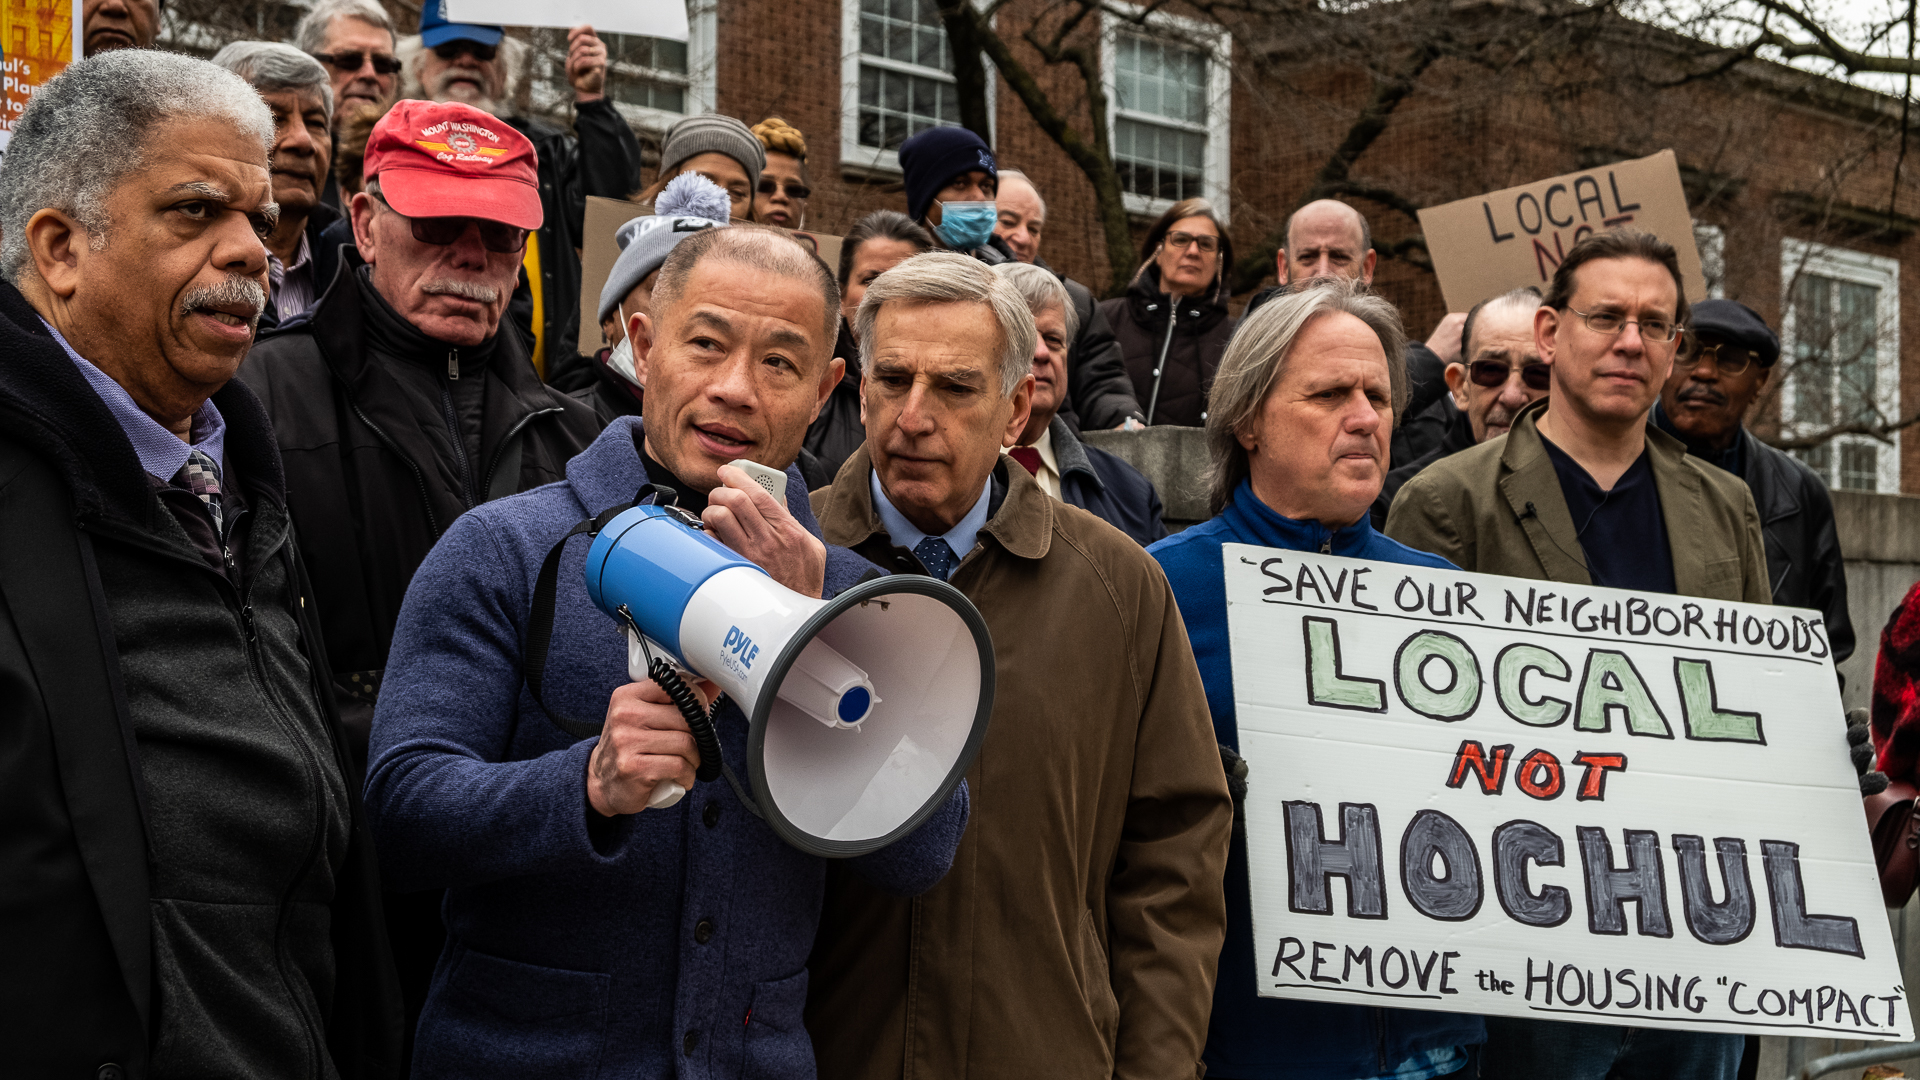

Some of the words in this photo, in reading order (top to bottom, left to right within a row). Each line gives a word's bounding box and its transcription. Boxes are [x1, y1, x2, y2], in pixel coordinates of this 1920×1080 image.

[421, 121, 448, 137] MOUNT
[450, 122, 500, 143] WASHINGTON
[437, 152, 454, 162] Cog
[456, 153, 493, 164] Railway
[1483, 171, 1641, 243] LOCAL
[1261, 557, 1379, 611] SAVE
[1395, 575, 1484, 622] OUR
[1505, 587, 1828, 658] NEIGHBORHOODS
[723, 625, 759, 669] PYLE
[1303, 615, 1767, 746] LOCAL
[1446, 740, 1628, 802] NOT
[1282, 800, 1866, 960] HOCHUL
[1272, 937, 1460, 995] REMOVE
[1475, 968, 1515, 996] the
[1524, 957, 1709, 1014] HOUSING
